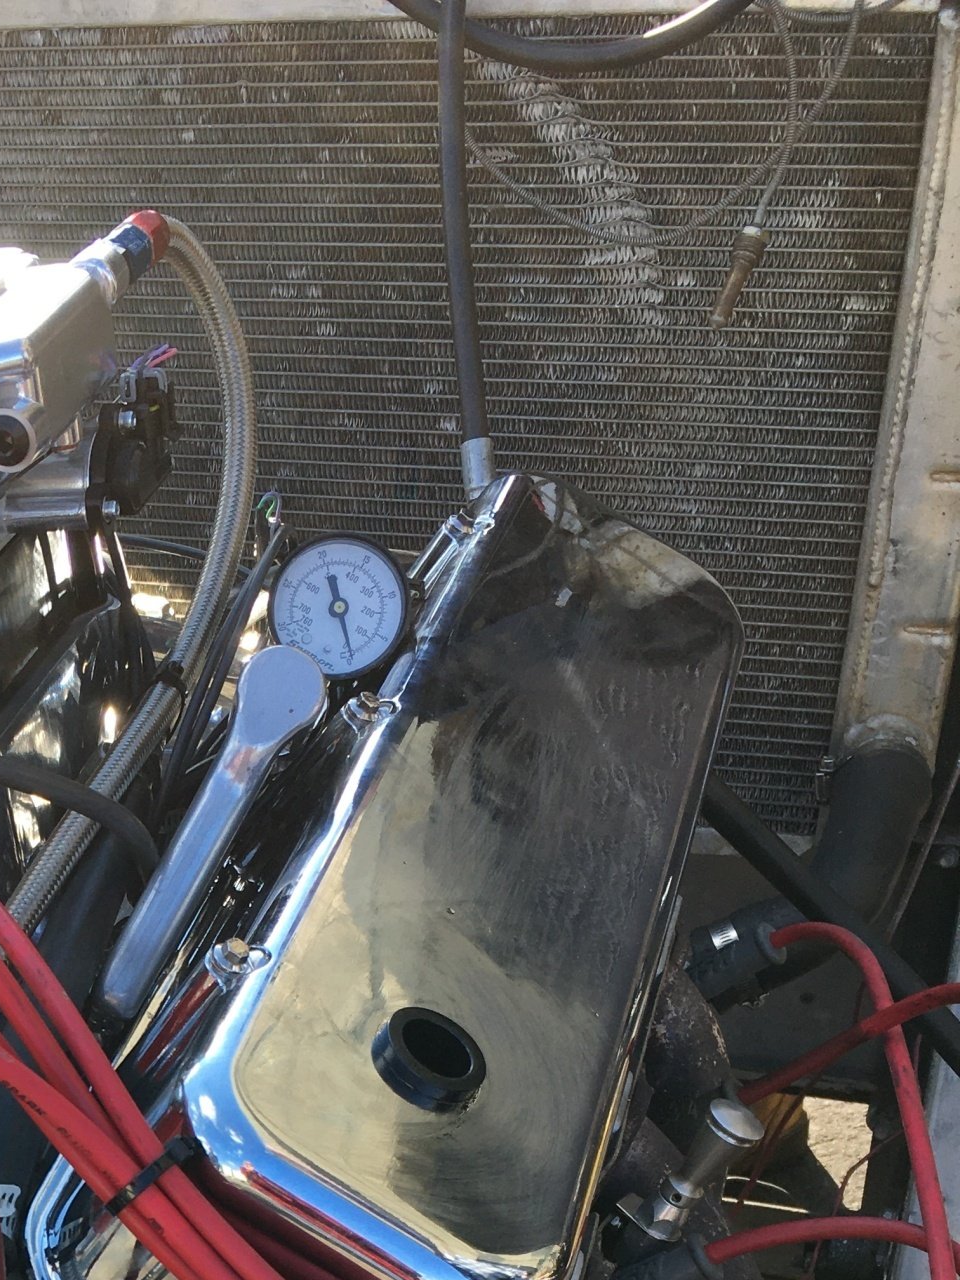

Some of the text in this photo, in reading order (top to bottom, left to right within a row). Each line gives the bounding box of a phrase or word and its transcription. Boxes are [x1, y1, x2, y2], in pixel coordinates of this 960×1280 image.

[345, 572, 360, 584] 400
[360, 586, 374, 598] 300
[298, 602, 312, 615] 700
[360, 606, 375, 618] 200
